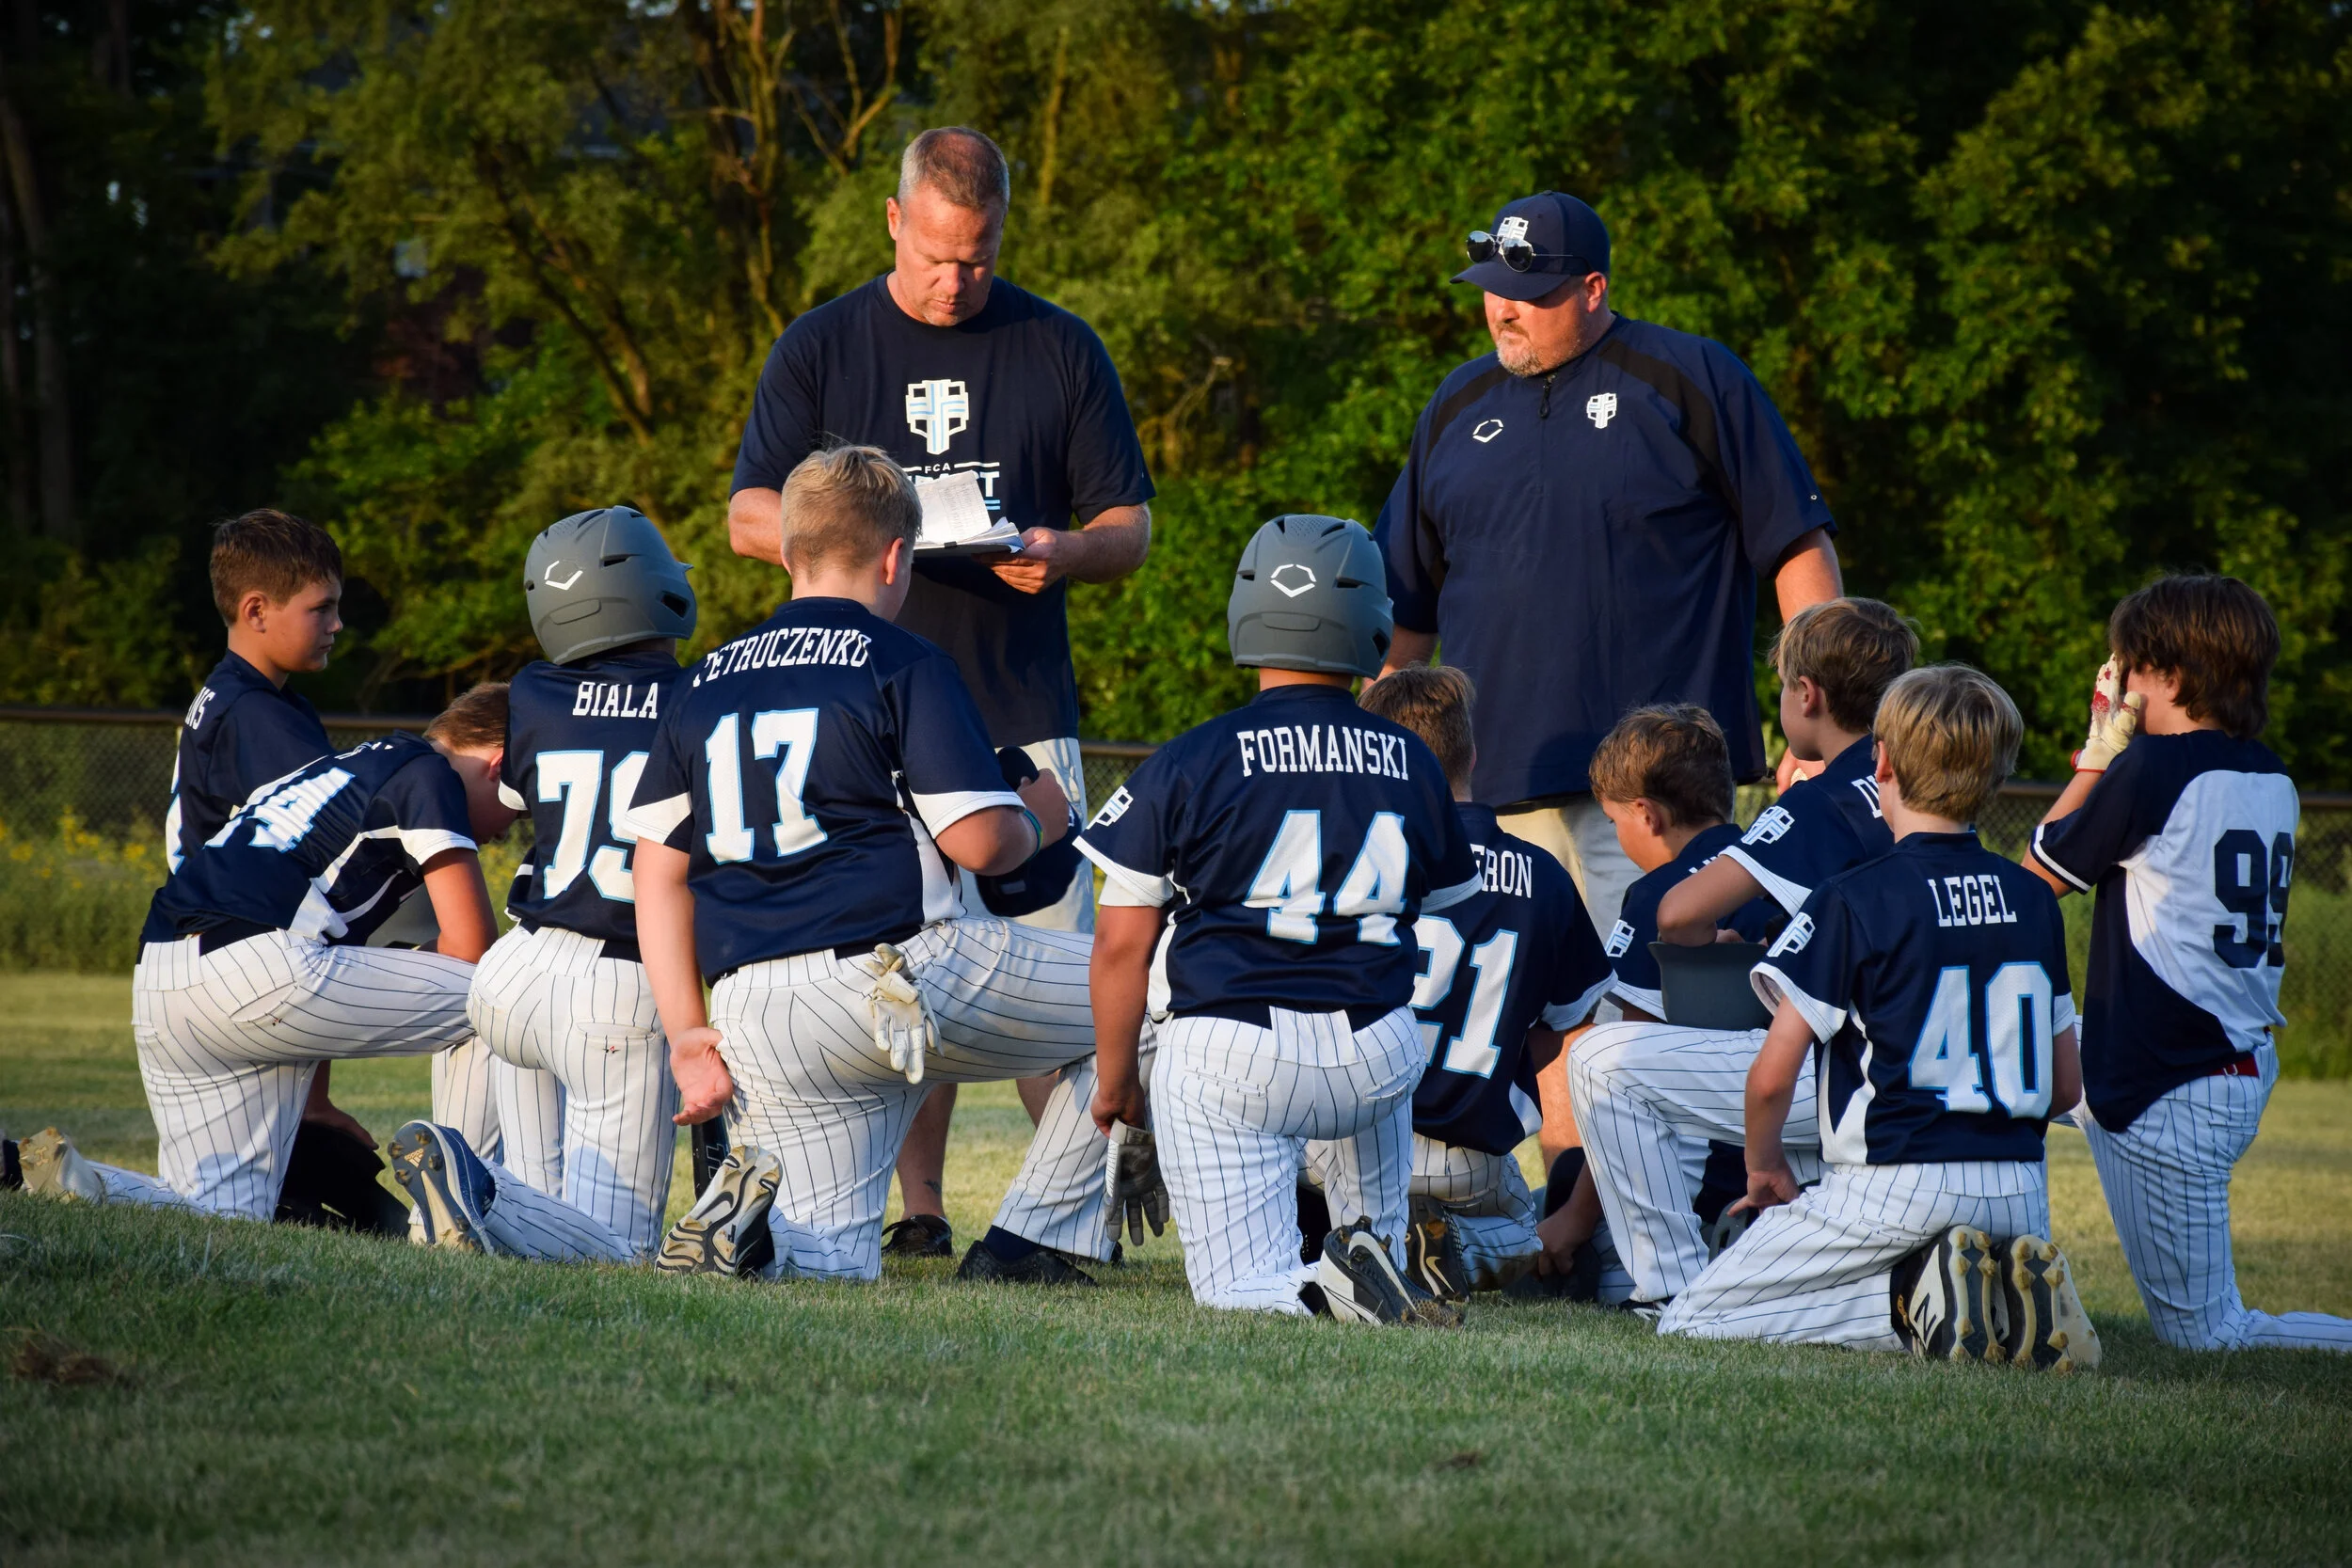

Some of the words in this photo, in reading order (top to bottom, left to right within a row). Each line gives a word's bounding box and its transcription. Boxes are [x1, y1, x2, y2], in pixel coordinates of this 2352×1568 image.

[925, 463, 951, 474] FCA
[572, 681, 659, 719] BIALA
[1236, 723, 1409, 781] FORMANSKI
[536, 751, 650, 904] 79
[705, 707, 828, 865] 17
[1243, 809, 1411, 946] 44
[1927, 874, 2017, 927] LEGEL
[1408, 915, 1518, 1079] 21
[1909, 961, 2054, 1119] 40
